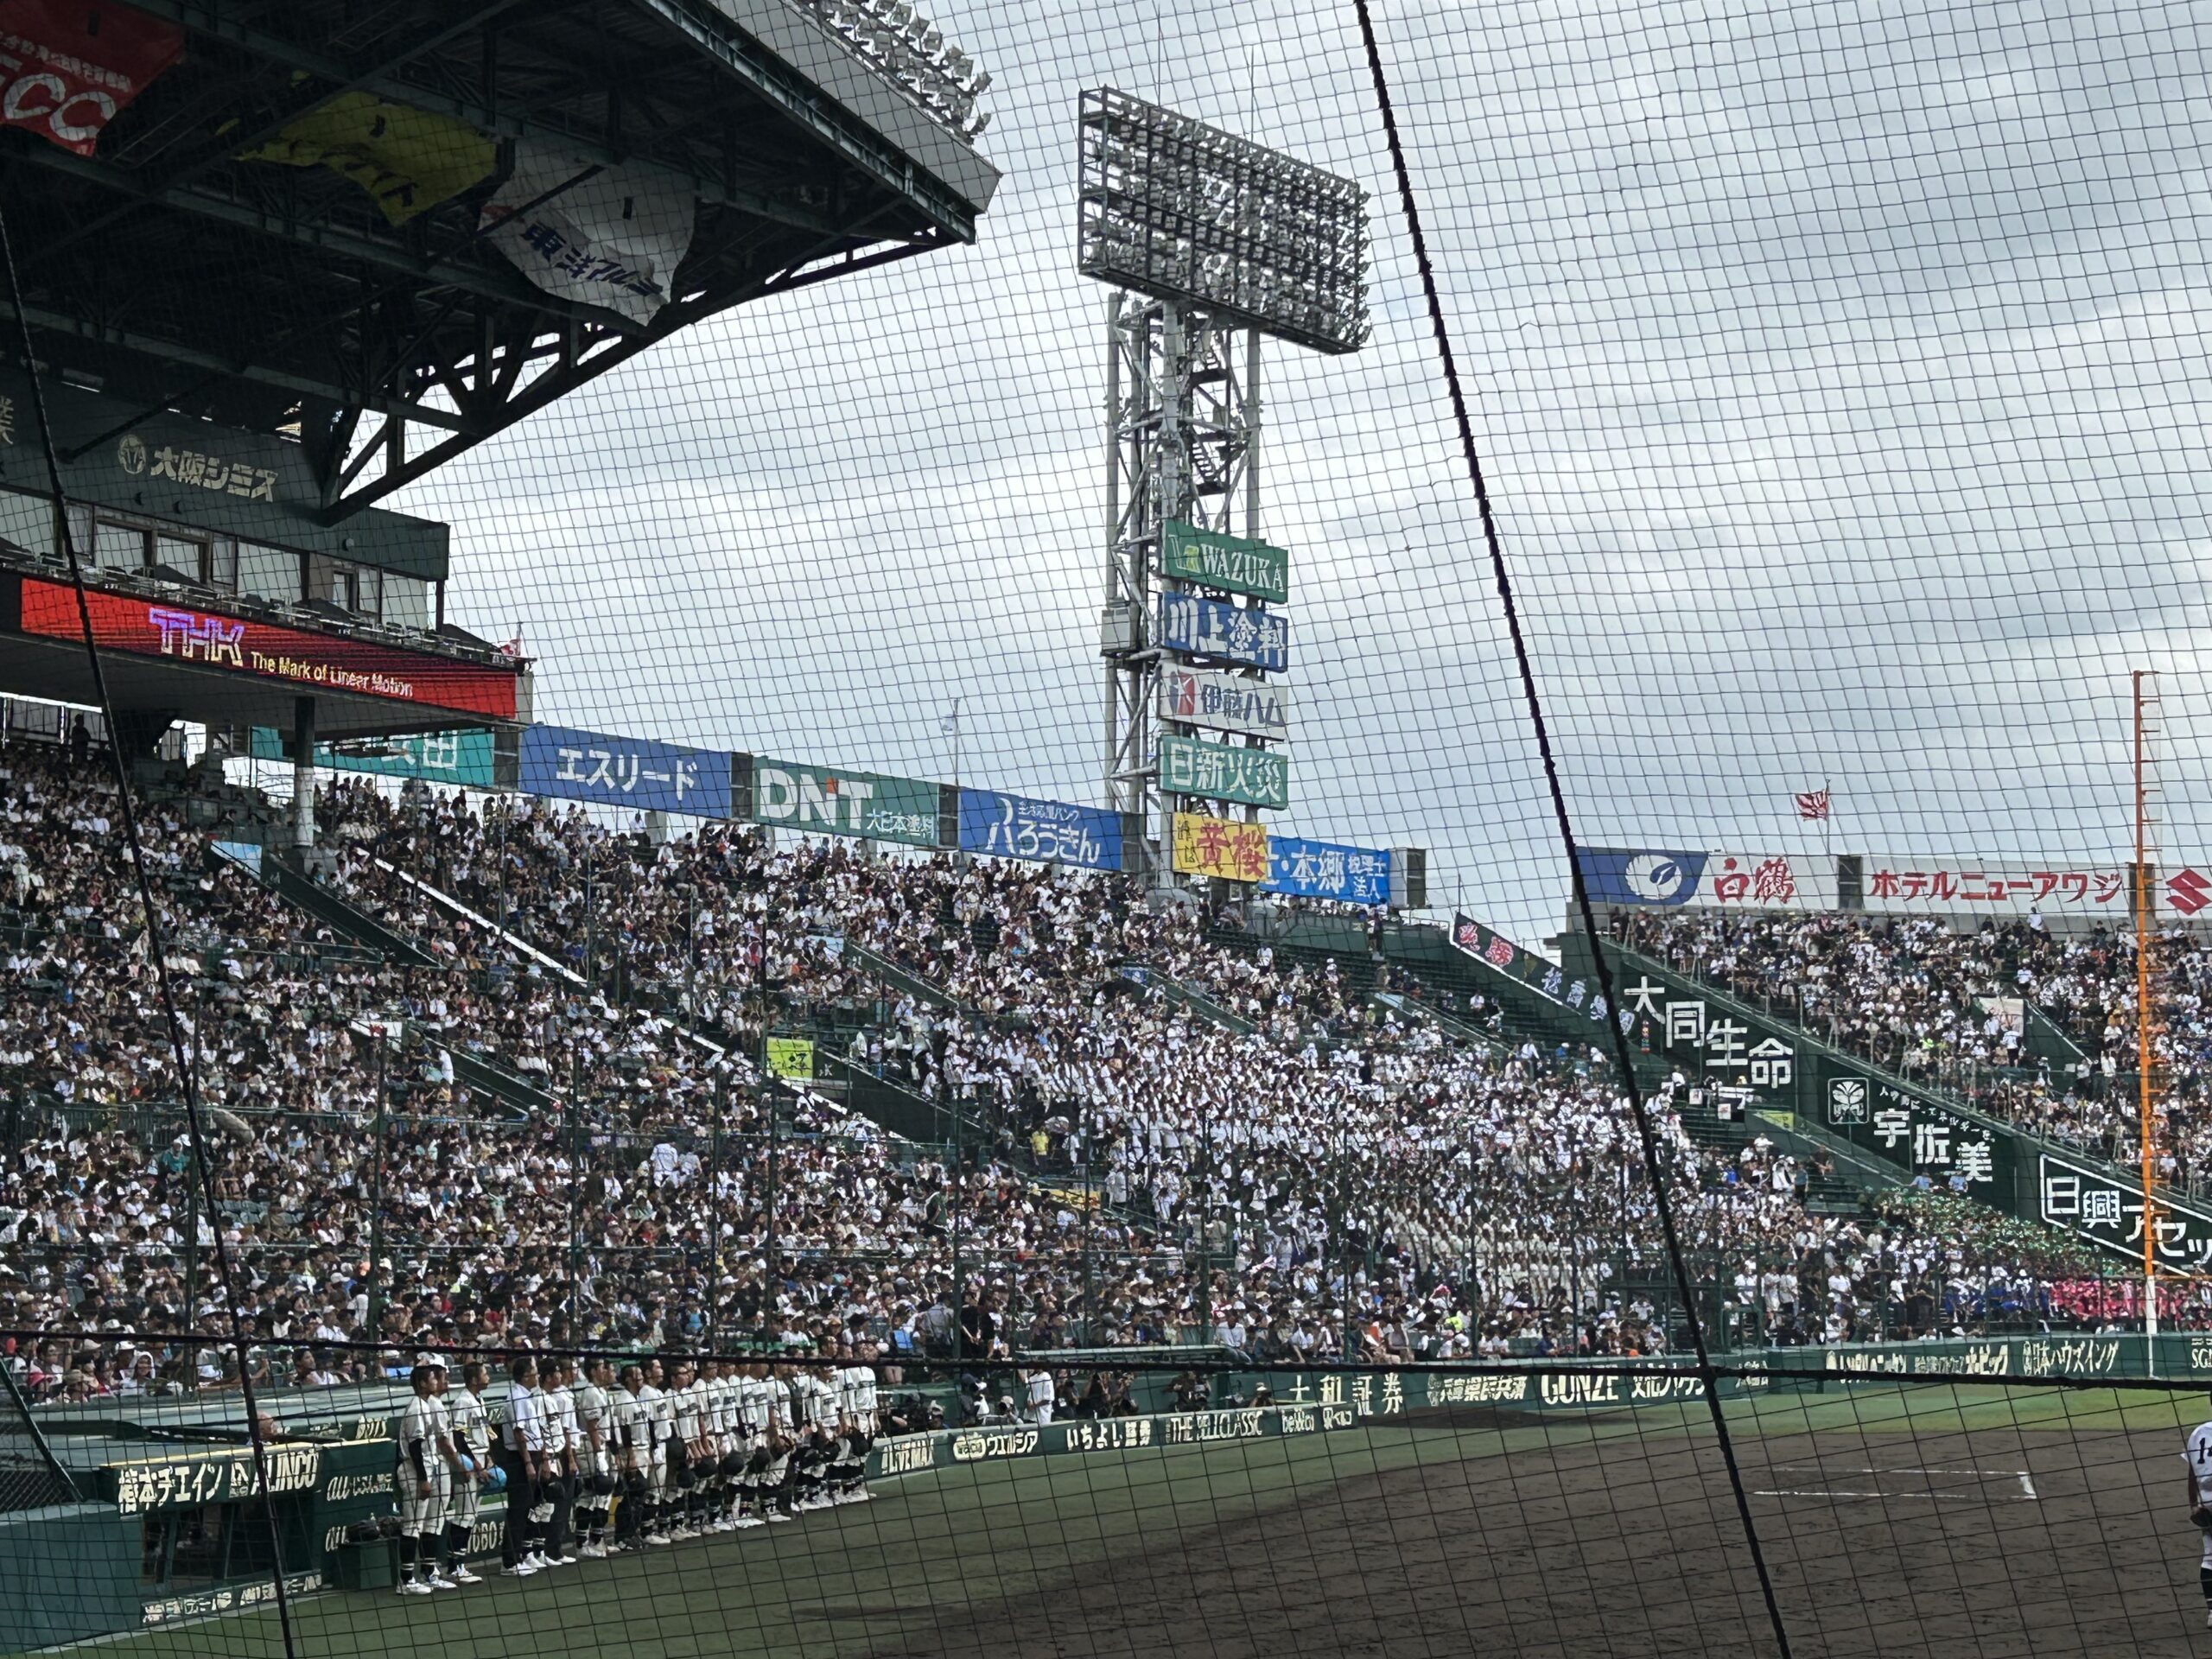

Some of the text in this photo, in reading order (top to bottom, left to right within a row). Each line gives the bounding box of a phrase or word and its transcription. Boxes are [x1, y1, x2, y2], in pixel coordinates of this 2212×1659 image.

[1200, 543, 1285, 593] WAZUKA
[149, 607, 245, 667] THK
[1169, 600, 1285, 668] 川上塗料
[251, 651, 413, 697] The Mark of Linear Motion
[1201, 683, 1285, 728] 伊藤ハム
[556, 747, 698, 801] エスリード
[1171, 741, 1281, 801] 日新火災
[759, 768, 874, 830] DNT
[1017, 818, 1101, 864] ろうきん
[1197, 822, 1267, 878] 黄桜
[1713, 855, 1796, 906] 白鶴
[1870, 868, 2125, 904] ホテルニューアワジ
[1624, 976, 1794, 1090] 大同生命
[1873, 1109, 1993, 1182] 宇佐美
[1541, 1365, 1619, 1406] GUNZE
[1171, 1416, 1193, 1443] THE
